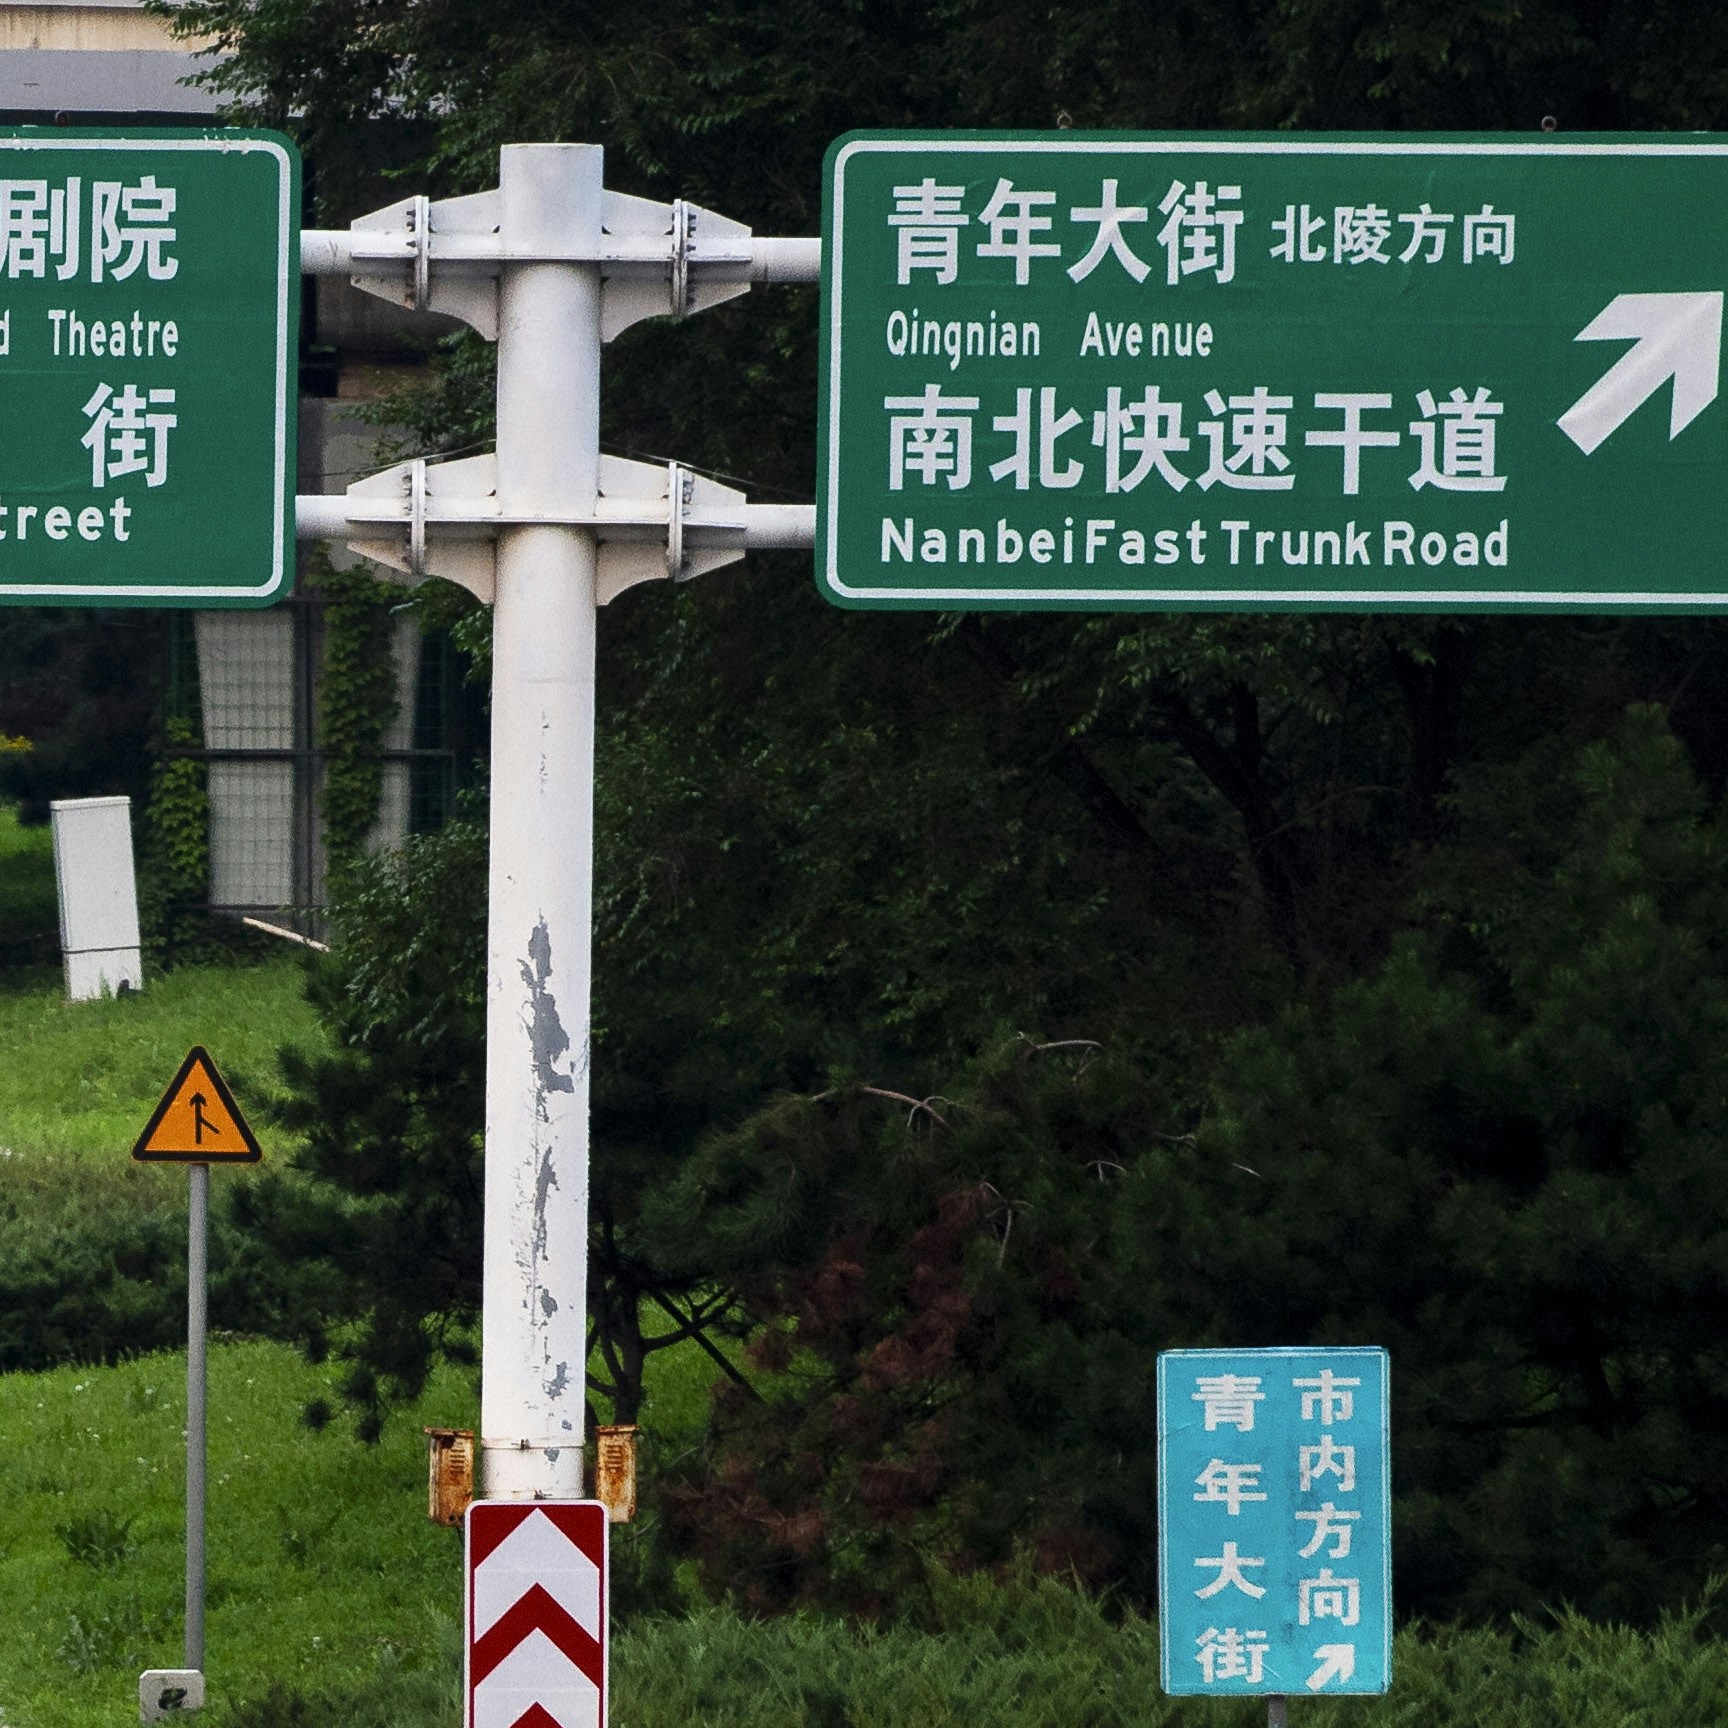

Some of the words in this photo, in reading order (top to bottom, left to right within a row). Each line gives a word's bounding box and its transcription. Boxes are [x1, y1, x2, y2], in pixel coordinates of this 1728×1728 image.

[887, 178, 1244, 286] 青年大街
[1269, 202, 1517, 265] 北陵方向
[47, 309, 179, 357] Theatre
[886, 310, 1041, 370] Qingnian
[1080, 311, 1214, 358] Avenue
[883, 383, 1508, 495] 南北快速干道
[1190, 1373, 1270, 1684] 青年大街
[1292, 1369, 1362, 1626] 市内方向
